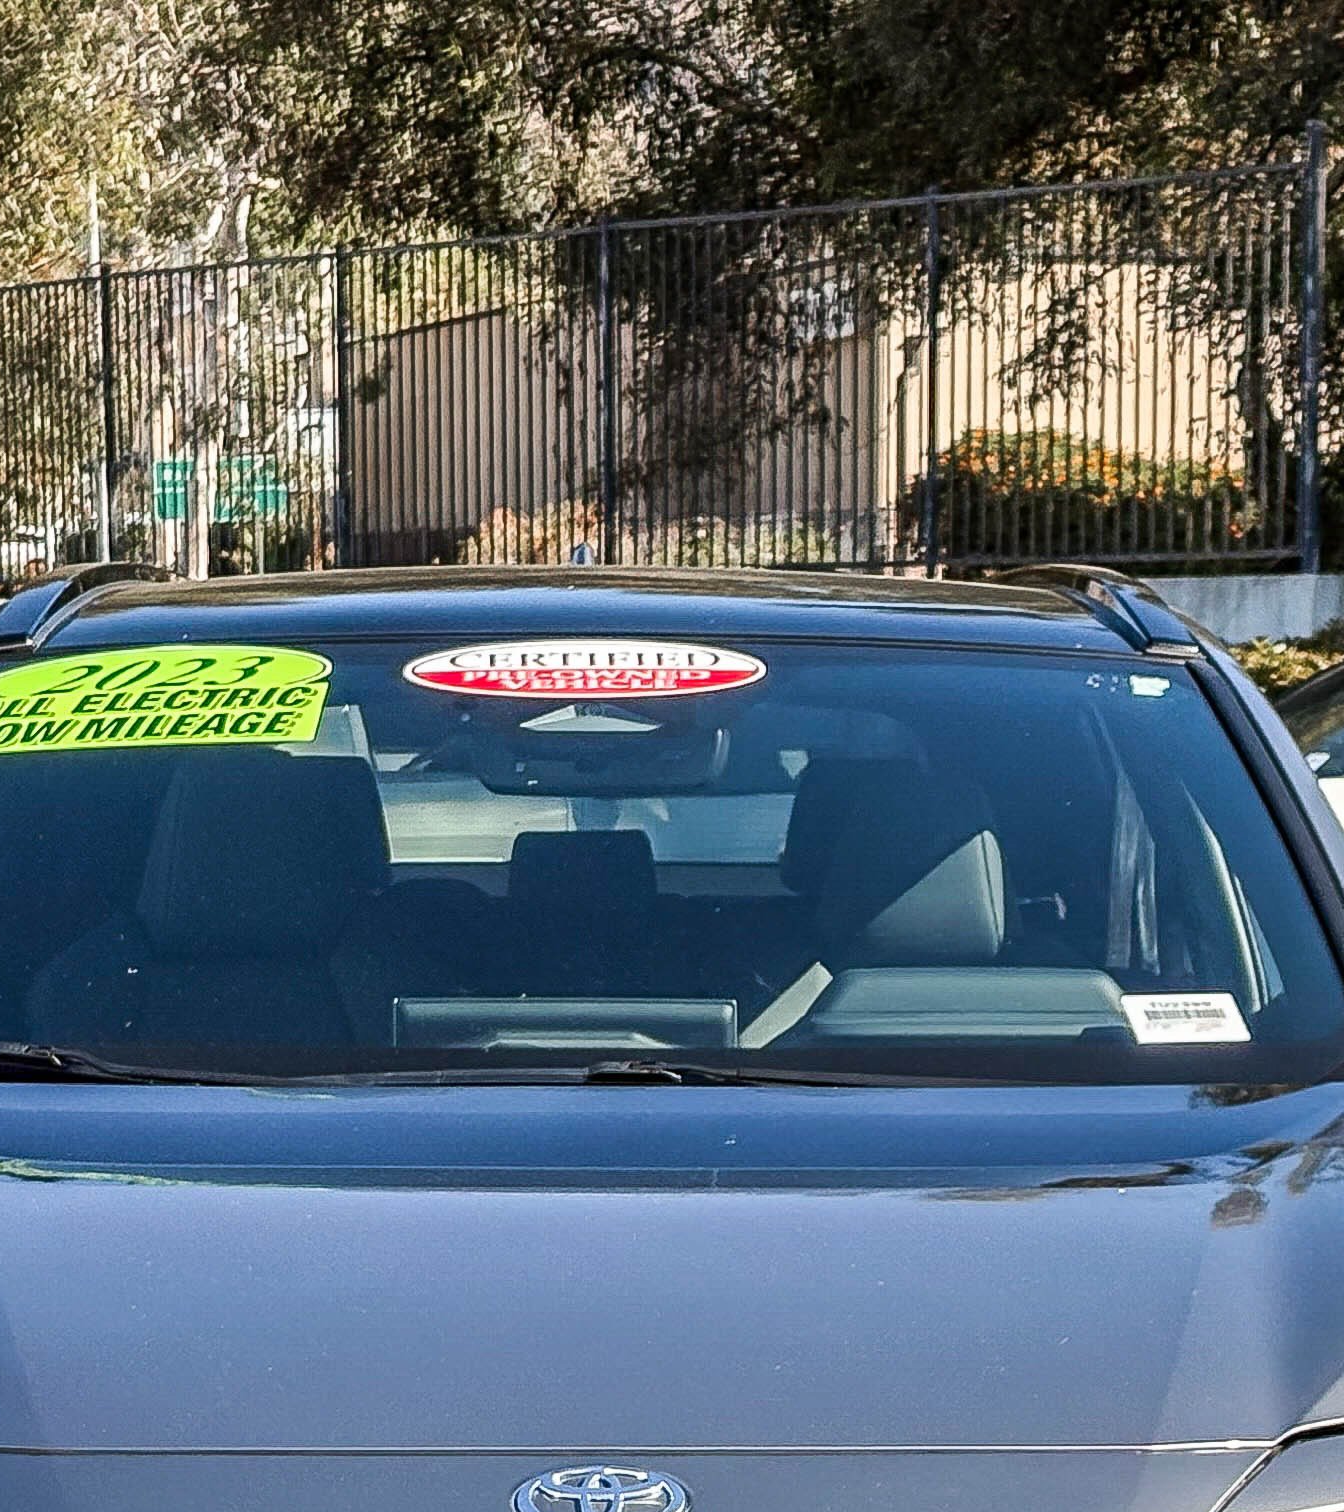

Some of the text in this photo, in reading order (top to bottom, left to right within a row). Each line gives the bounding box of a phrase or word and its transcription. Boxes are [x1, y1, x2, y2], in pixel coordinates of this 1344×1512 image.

[449, 651, 721, 668] CERTIFIED
[31, 655, 275, 697] 2023
[501, 678, 678, 690] VEHICLE
[73, 686, 317, 716] ELECTRIC
[76, 711, 304, 742] MILEAGE
